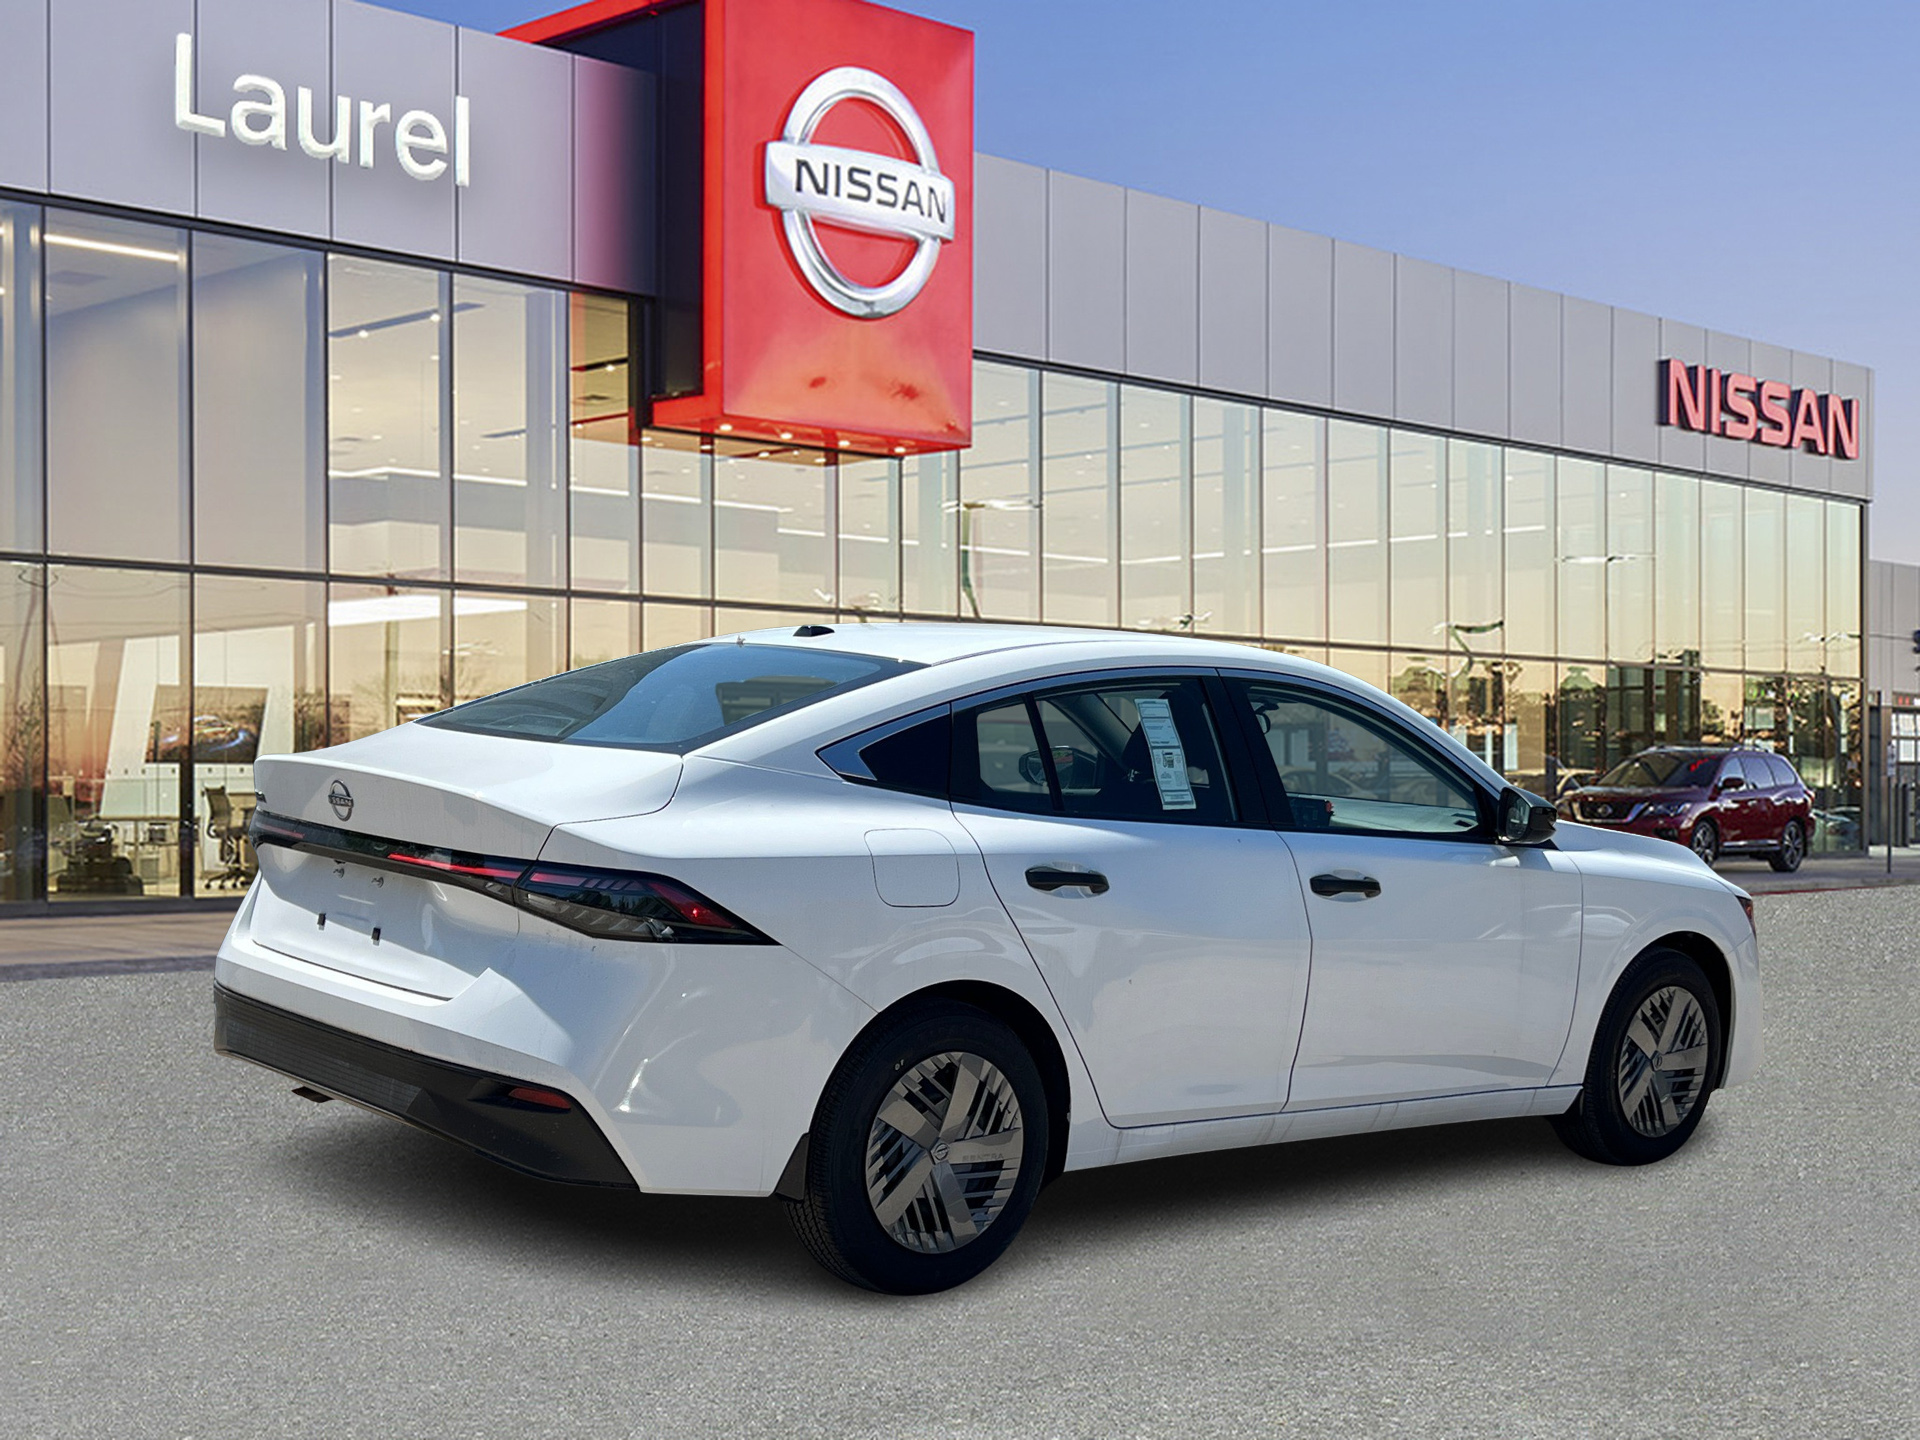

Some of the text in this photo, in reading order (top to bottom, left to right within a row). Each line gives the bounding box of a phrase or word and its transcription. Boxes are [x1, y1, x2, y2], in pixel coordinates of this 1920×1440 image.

[174, 32, 470, 188] Laurel
[796, 158, 946, 223] NISSAN
[1656, 358, 1859, 460] NISSAN
